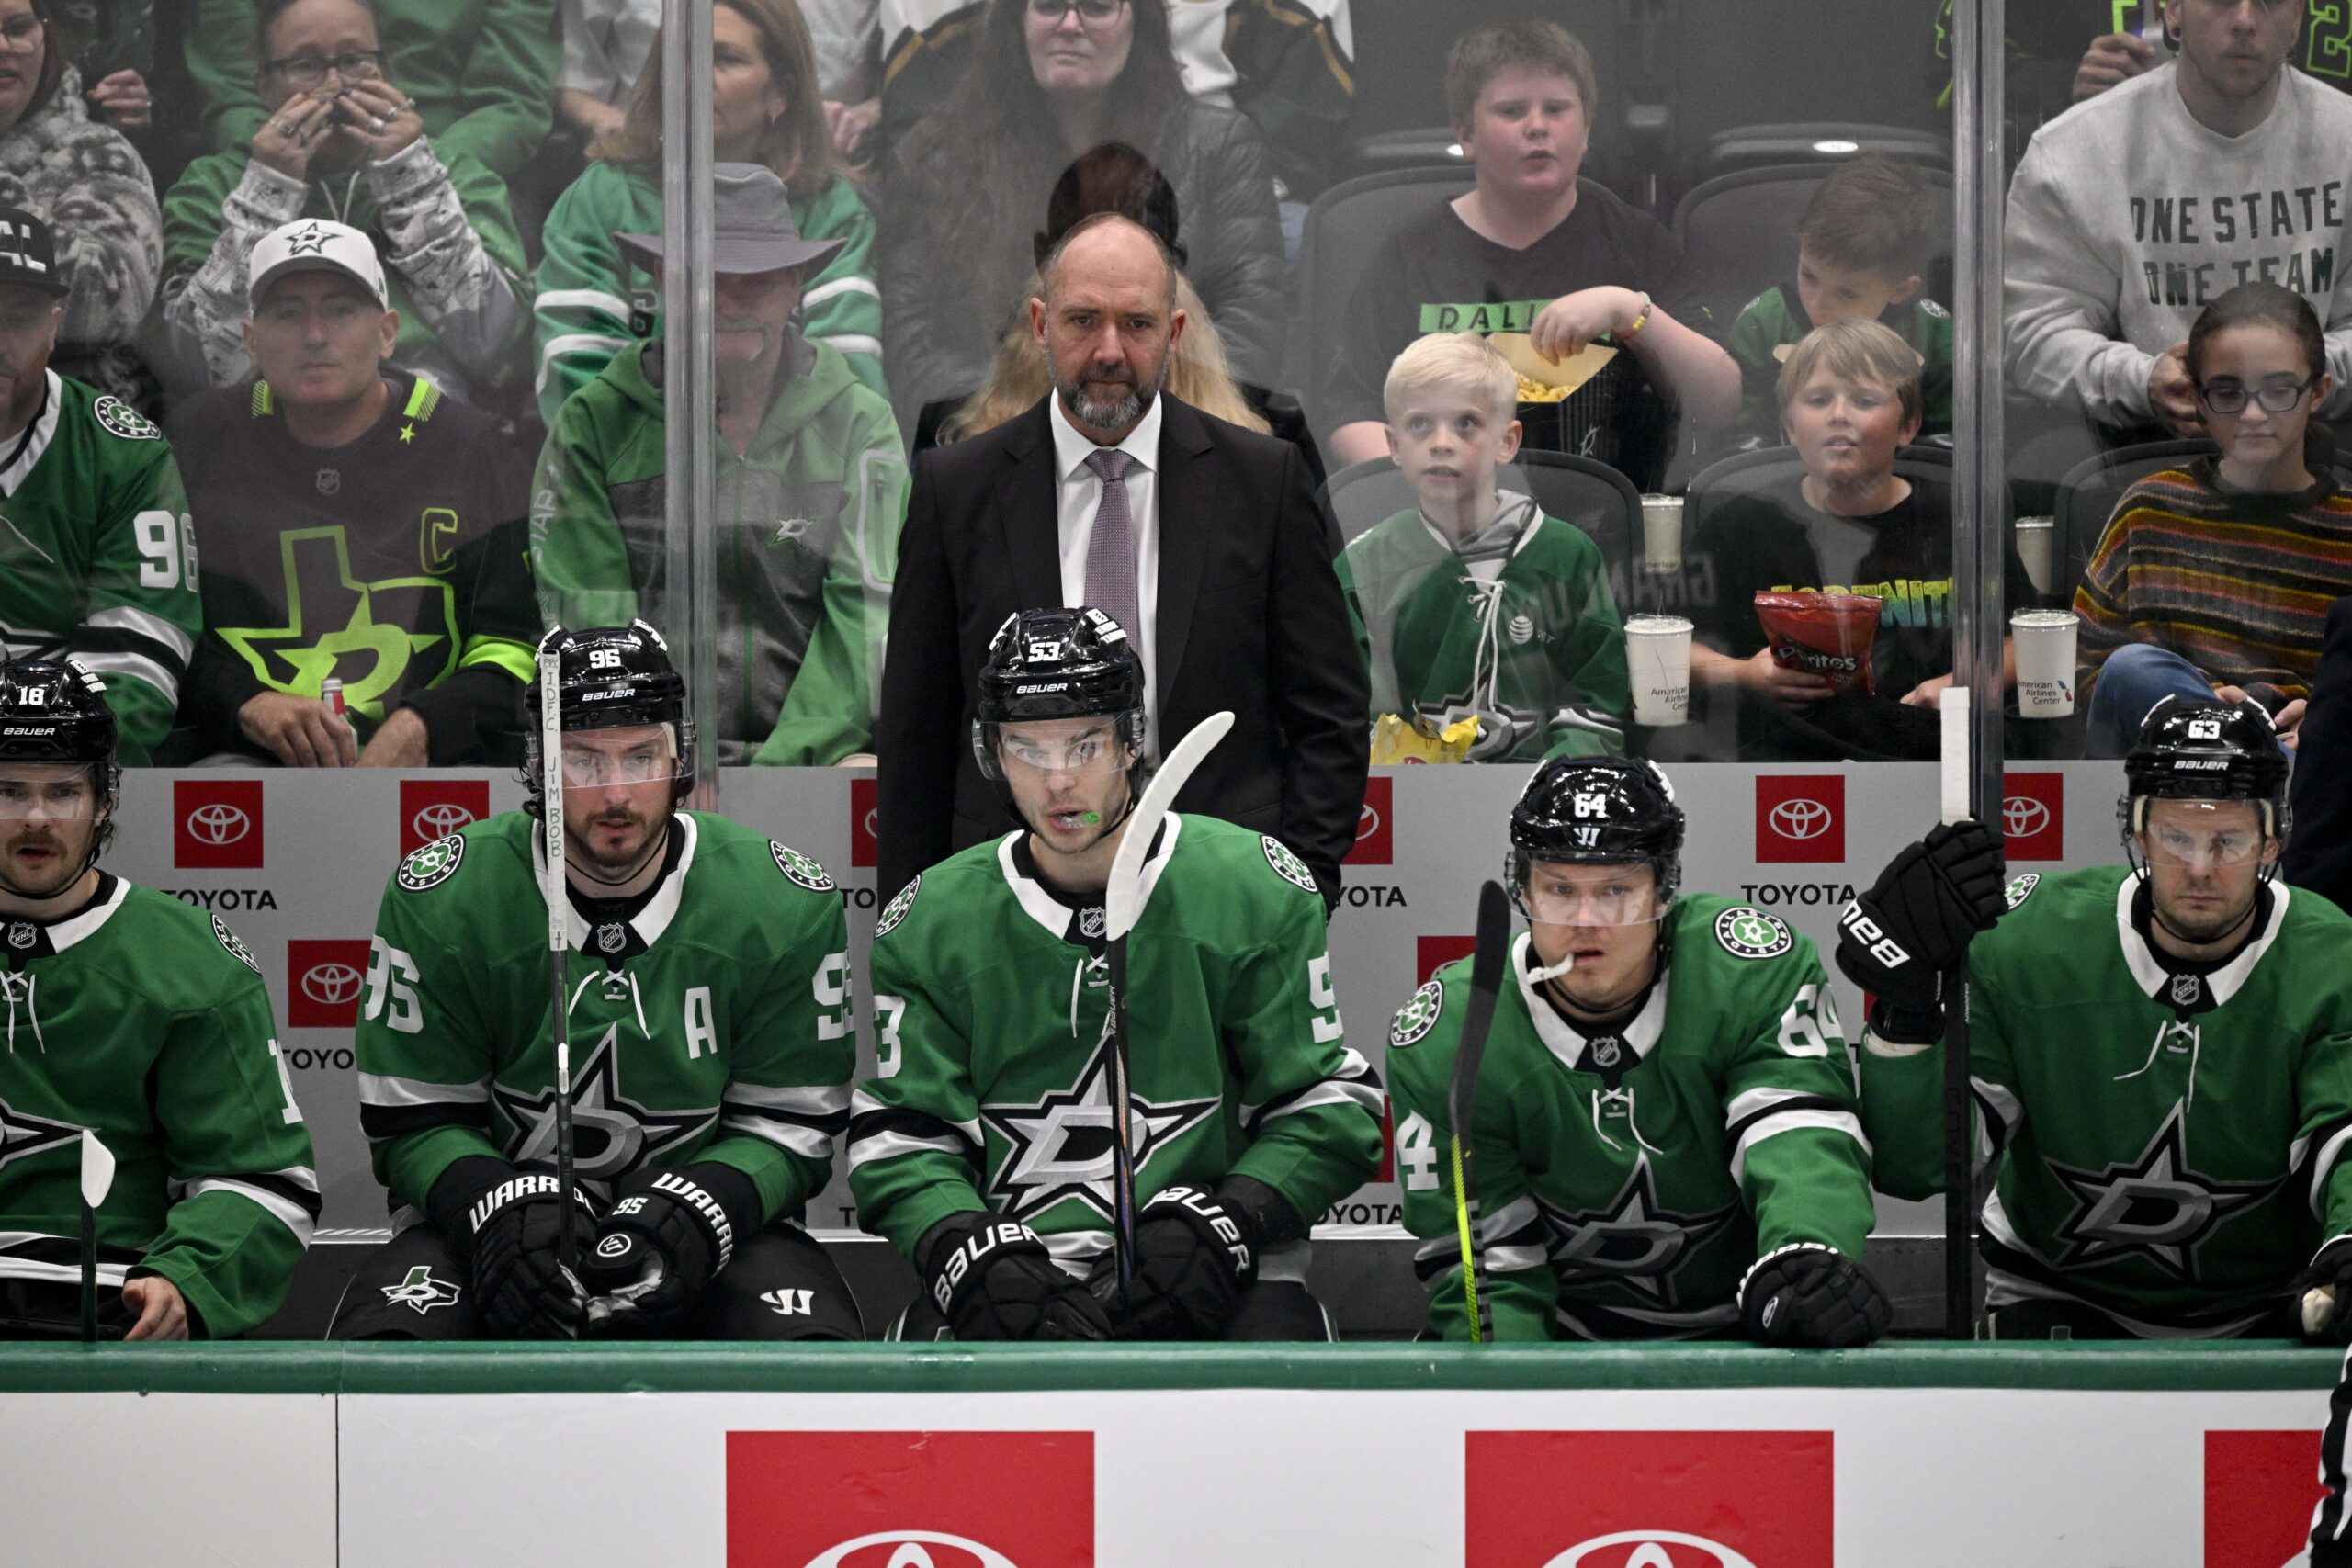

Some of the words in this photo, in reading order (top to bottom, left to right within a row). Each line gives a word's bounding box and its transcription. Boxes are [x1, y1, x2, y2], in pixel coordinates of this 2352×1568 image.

[2212, 181, 2342, 243] STATE
[2143, 261, 2214, 306] ONE
[1439, 303, 1535, 330] DALL
[420, 507, 458, 574] C
[589, 649, 621, 669] 95
[1028, 642, 1060, 662] 53
[1778, 646, 1857, 671] Dritos
[18, 687, 45, 705] 18
[582, 689, 636, 701] BAUER
[1016, 682, 1068, 694] BAUER
[3, 727, 55, 736] BAUER
[2188, 720, 2221, 739] 63
[2174, 761, 2229, 771] BAUER
[1574, 793, 1606, 818] 64
[549, 808, 561, 857] BOB
[1337, 886, 1408, 908] YOTA
[1741, 884, 1856, 905] TOYOTA
[364, 933, 424, 1033] 95
[684, 986, 718, 1059] A
[612, 1197, 647, 1215] 95
